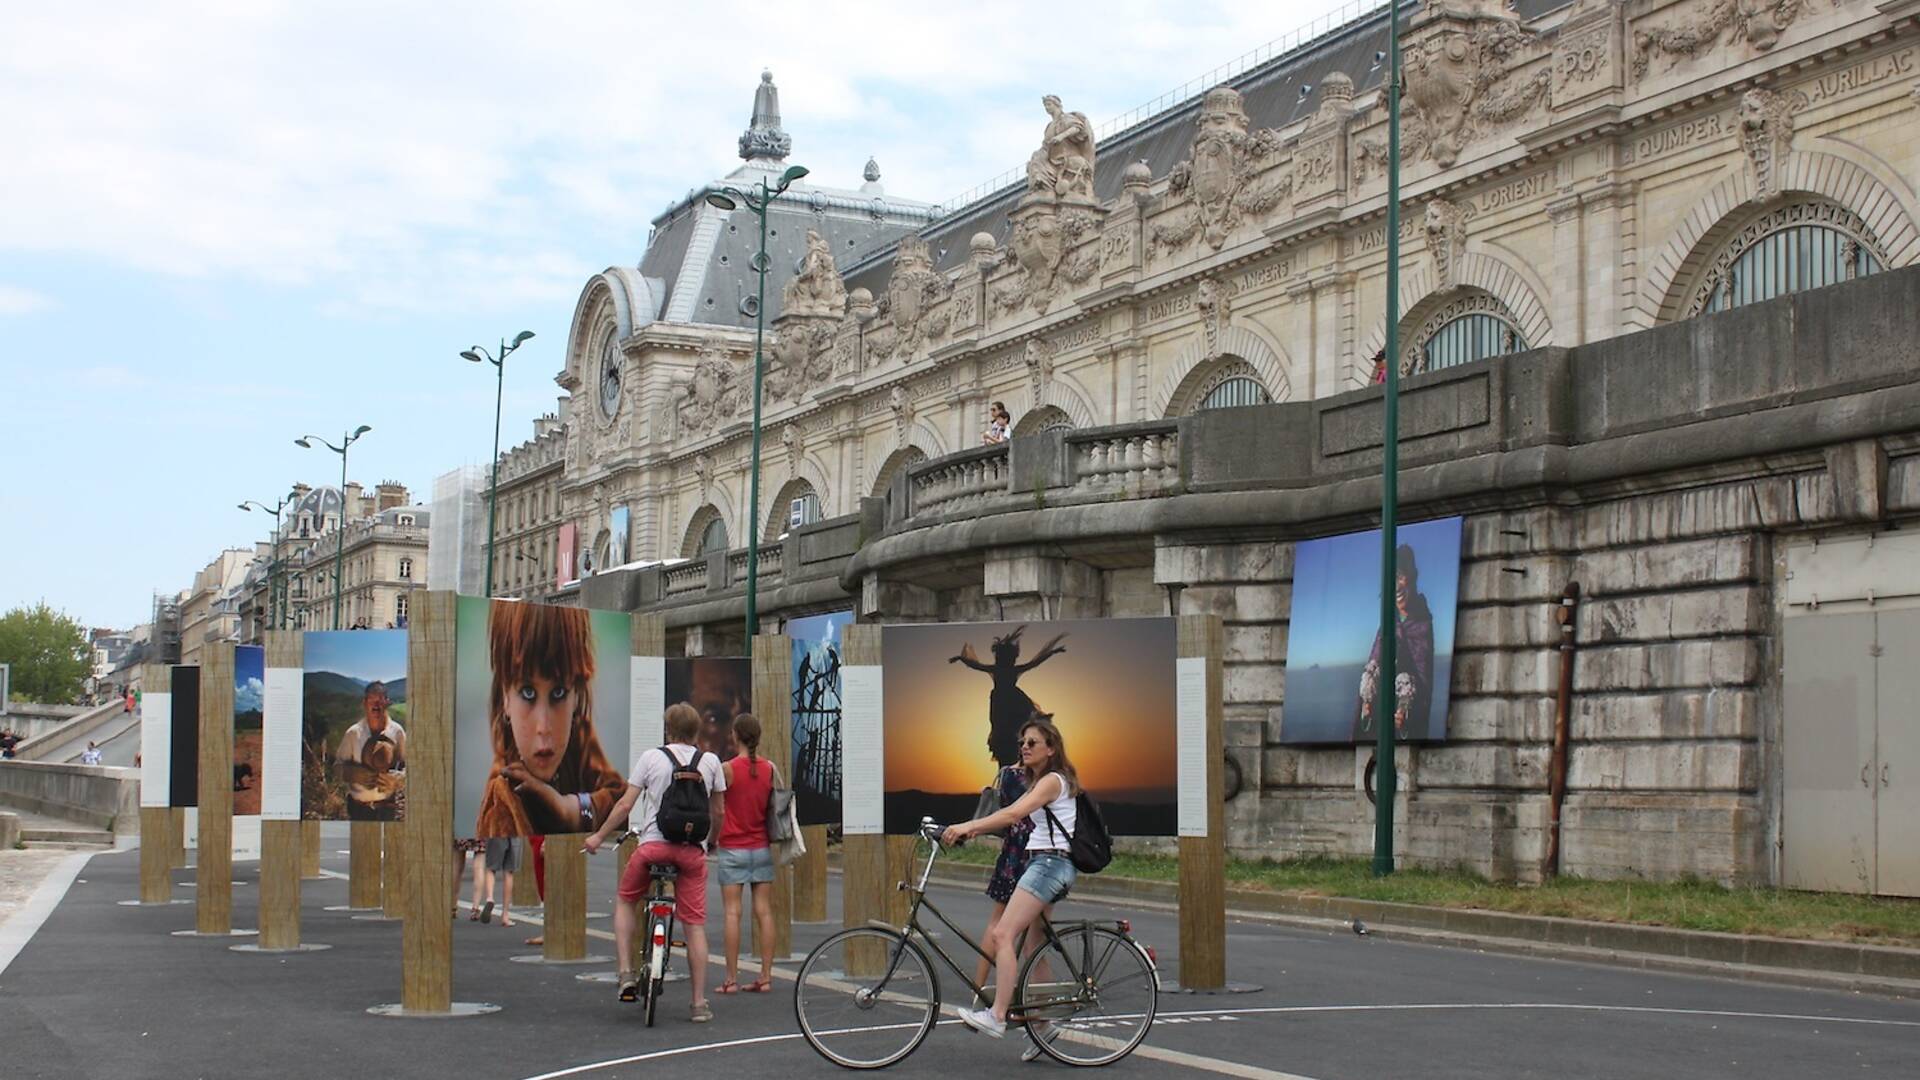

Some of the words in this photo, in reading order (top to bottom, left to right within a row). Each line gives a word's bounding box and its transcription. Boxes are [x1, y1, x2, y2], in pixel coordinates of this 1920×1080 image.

[1813, 50, 1913, 102] AURILLAC
[1640, 114, 1721, 158] QUIMPER
[1481, 173, 1548, 211] LORIENT
[1359, 218, 1413, 251] VANES
[1241, 262, 1289, 292] ANGERS
[1150, 294, 1191, 321] NANTES
